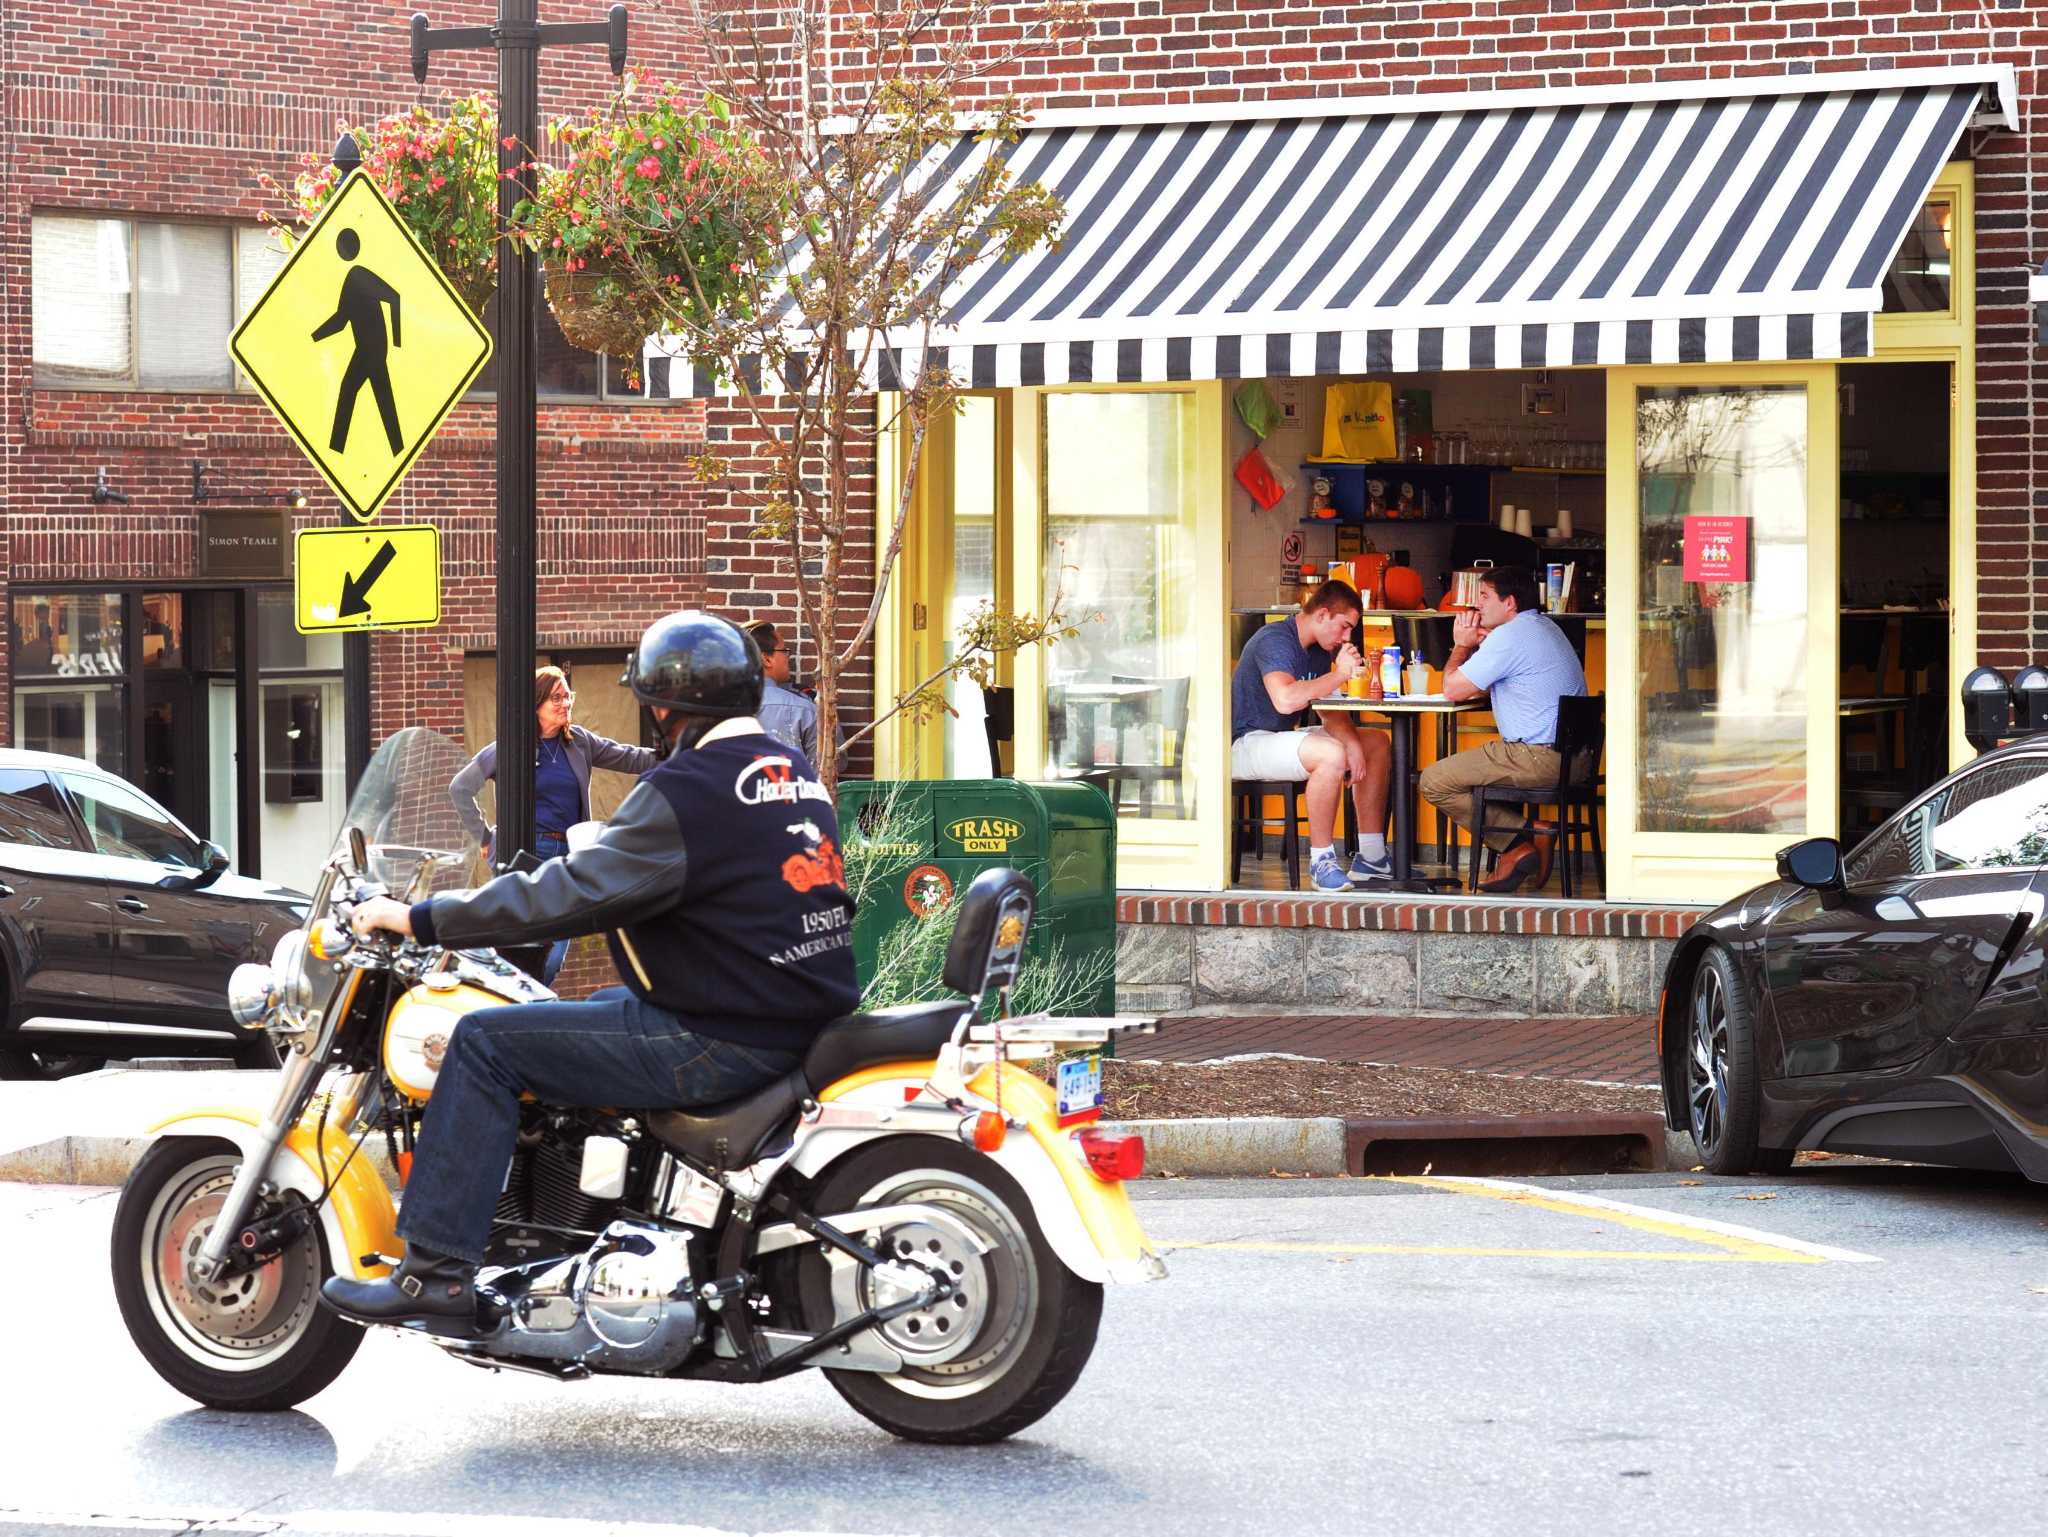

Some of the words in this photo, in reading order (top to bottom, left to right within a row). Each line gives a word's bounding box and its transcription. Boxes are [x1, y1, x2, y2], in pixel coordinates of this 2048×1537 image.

[208, 536, 239, 546] SIMON
[952, 820, 1018, 838] TRASH
[869, 843, 919, 855] OTTLES
[969, 842, 1001, 850] ONLY
